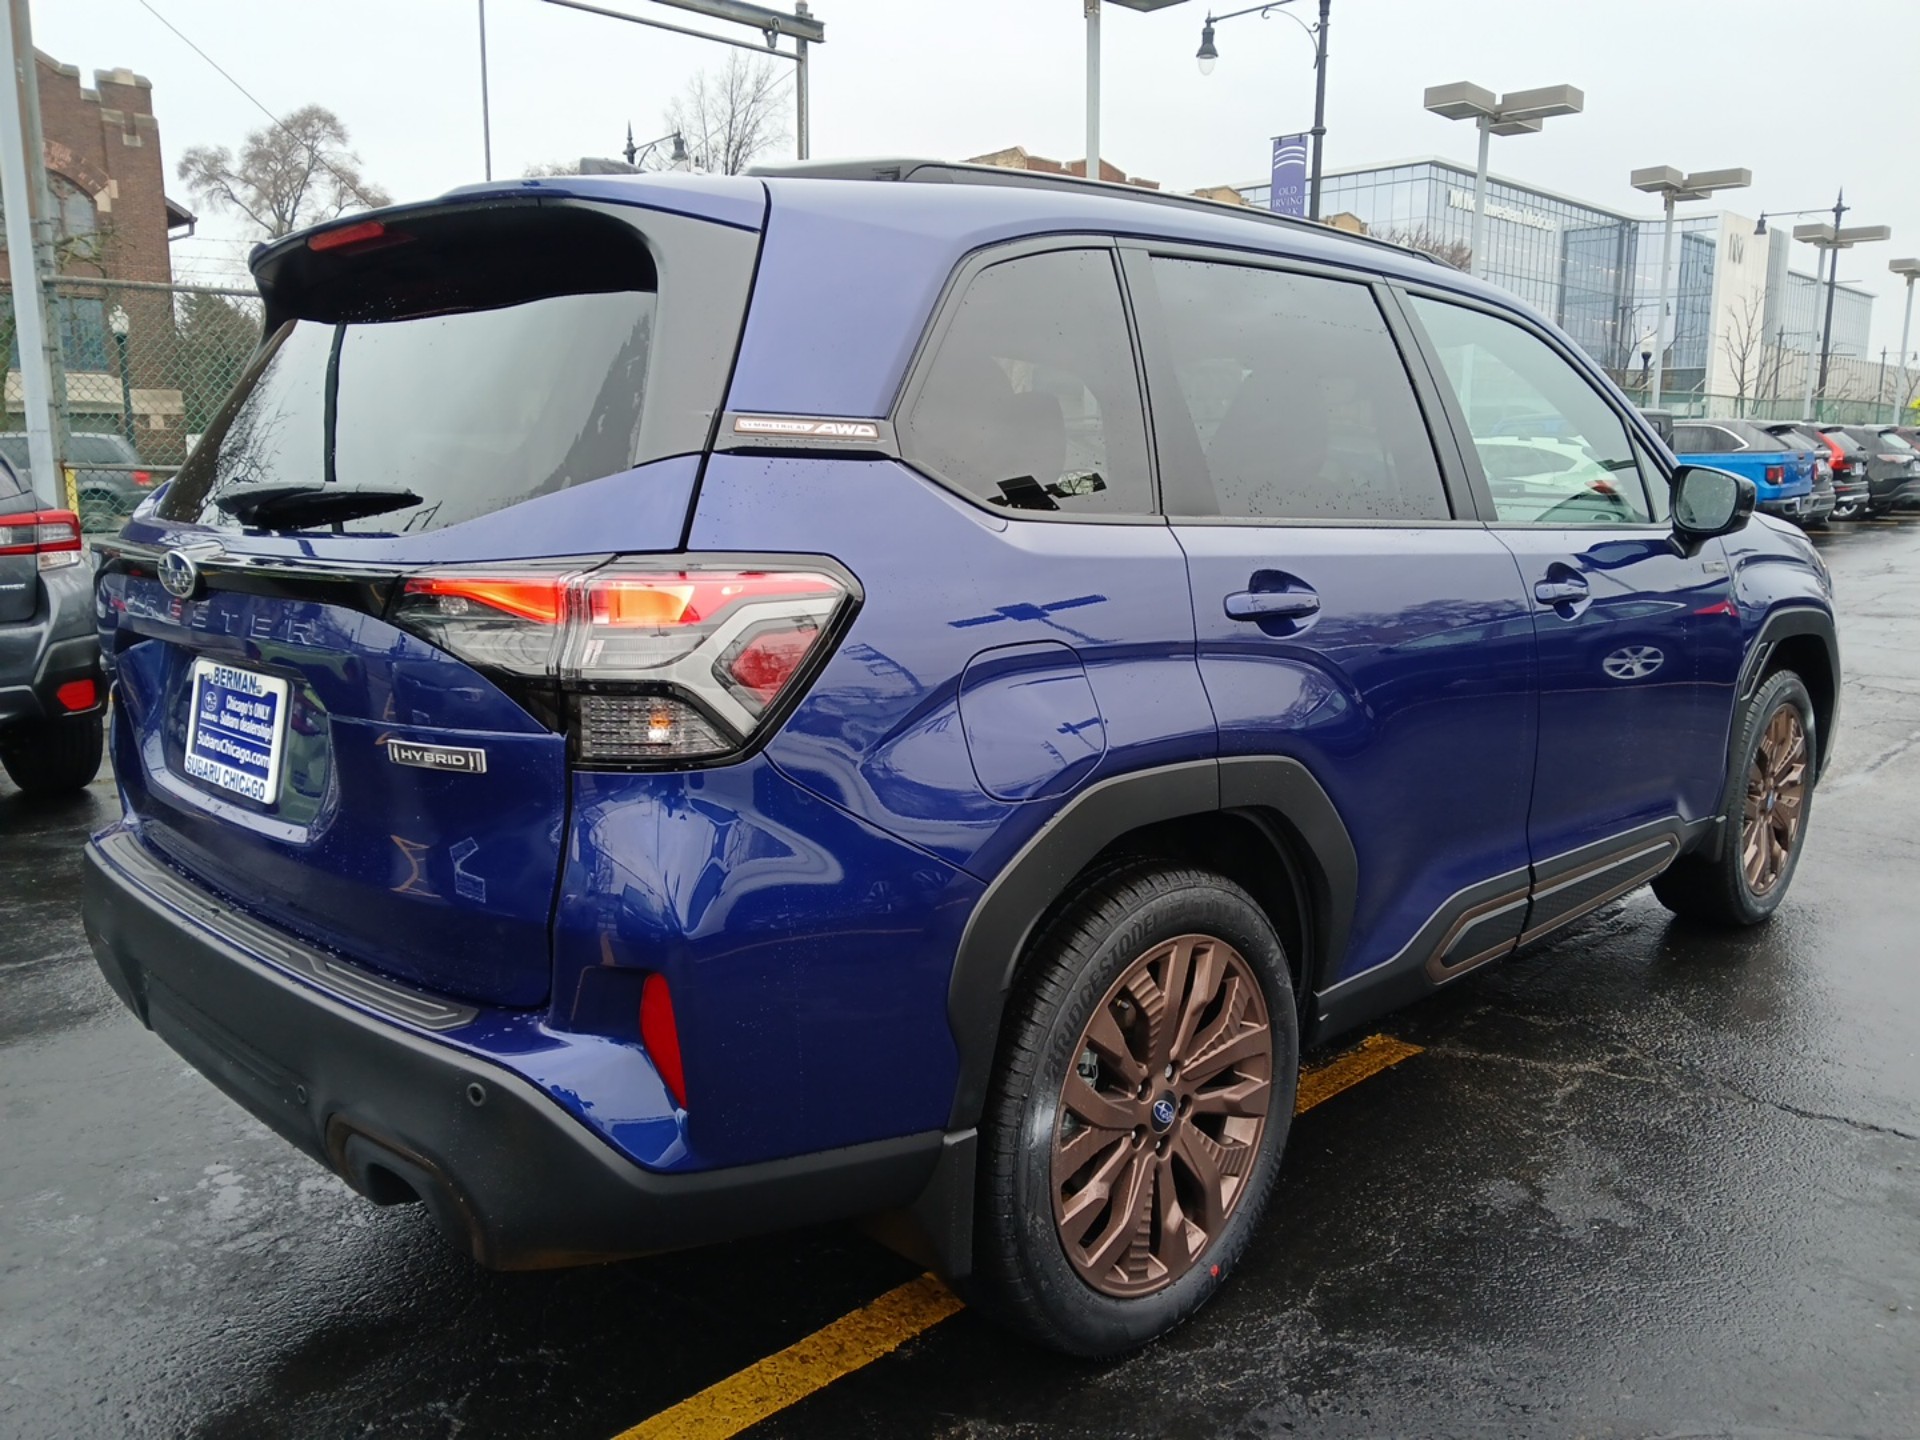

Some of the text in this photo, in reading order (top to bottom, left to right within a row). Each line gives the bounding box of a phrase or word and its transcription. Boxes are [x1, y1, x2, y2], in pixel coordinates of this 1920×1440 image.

[1278, 185, 1298, 196] OLD
[1272, 195, 1303, 208] IRVING
[813, 422, 878, 437] AWD
[213, 667, 257, 694] BERMAN
[226, 694, 272, 721] Chicago's ONLY
[219, 710, 240, 729] Subaru
[197, 730, 270, 769] SubaruChicago.com
[400, 748, 466, 766] HYBRID
[186, 755, 266, 800] SUBARU CHICAGO
